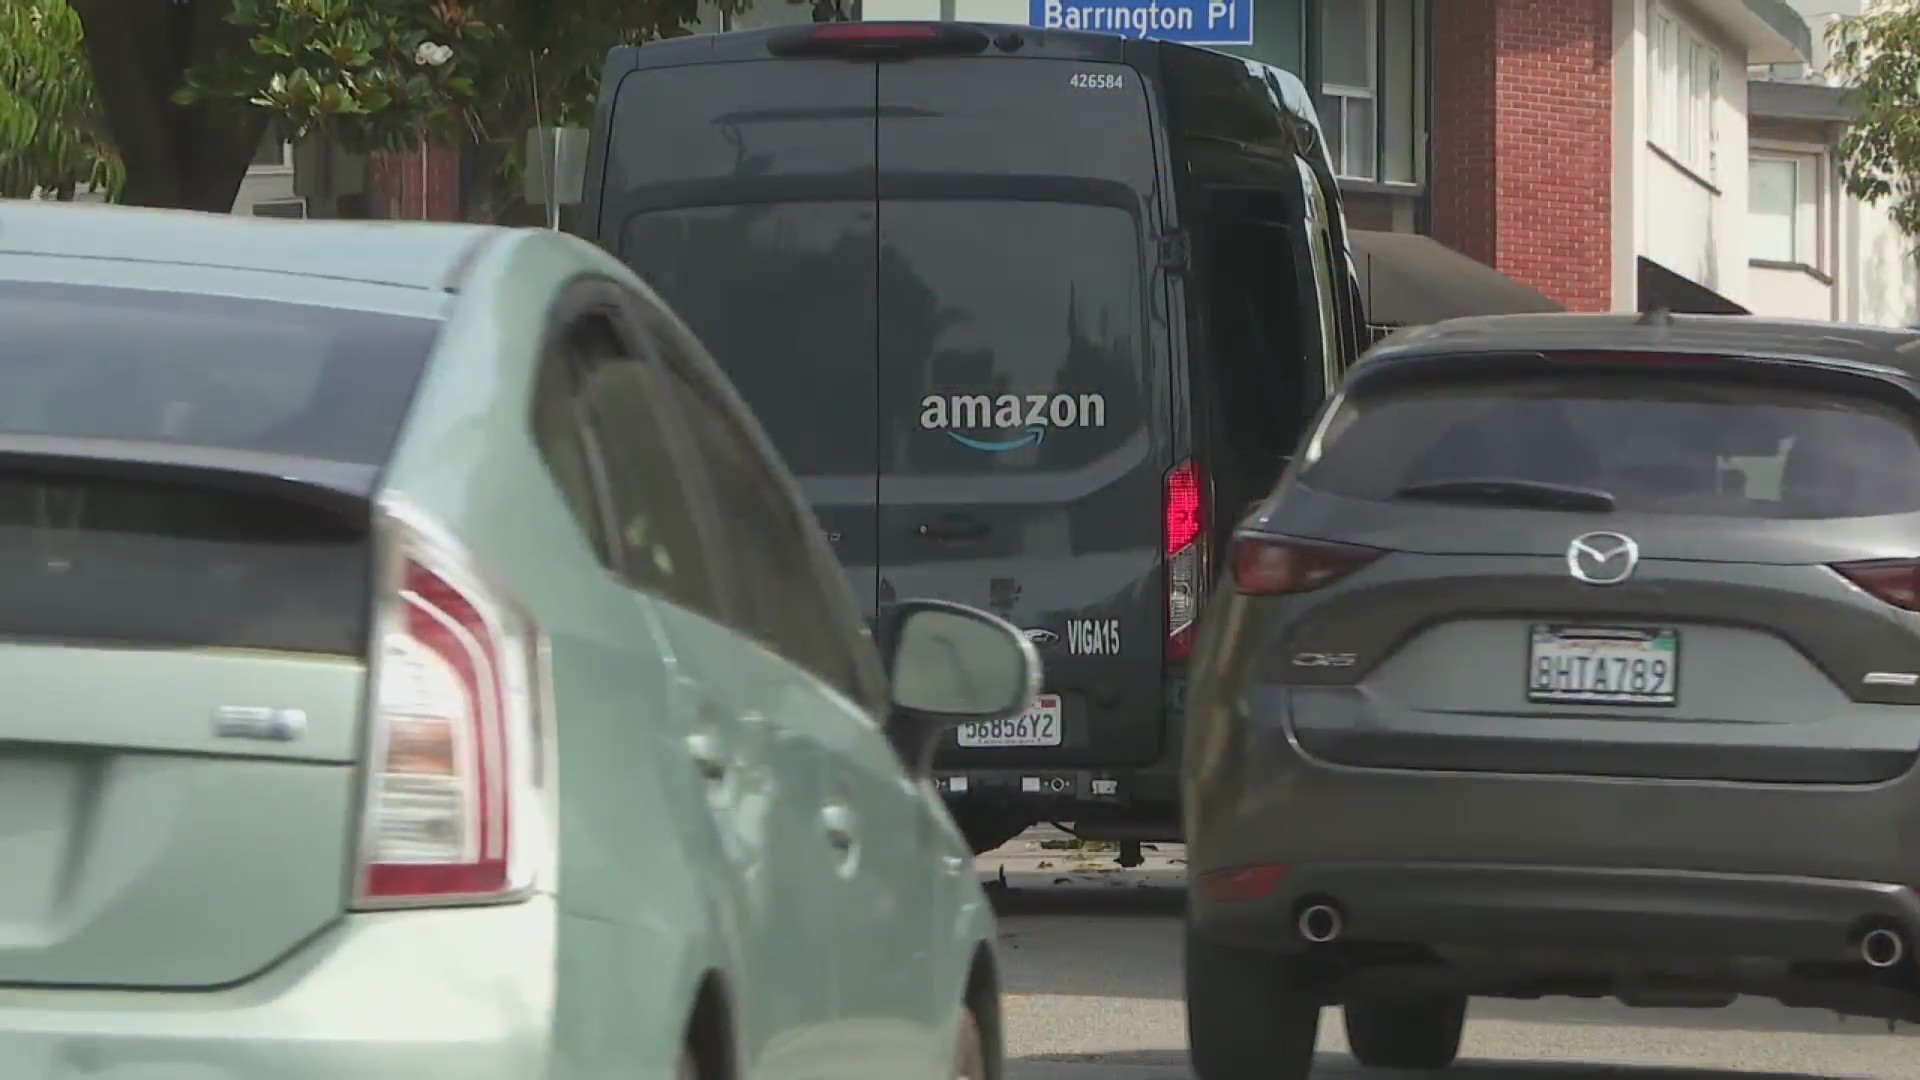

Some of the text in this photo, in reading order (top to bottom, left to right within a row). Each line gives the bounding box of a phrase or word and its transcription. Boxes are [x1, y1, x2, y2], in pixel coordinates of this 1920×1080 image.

[1044, 0, 1193, 39] Barrington
[1070, 74, 1123, 88] 426584
[920, 392, 1106, 429] amazon
[1067, 619, 1120, 655] VIGA15
[1538, 655, 1666, 693] 8HTA789
